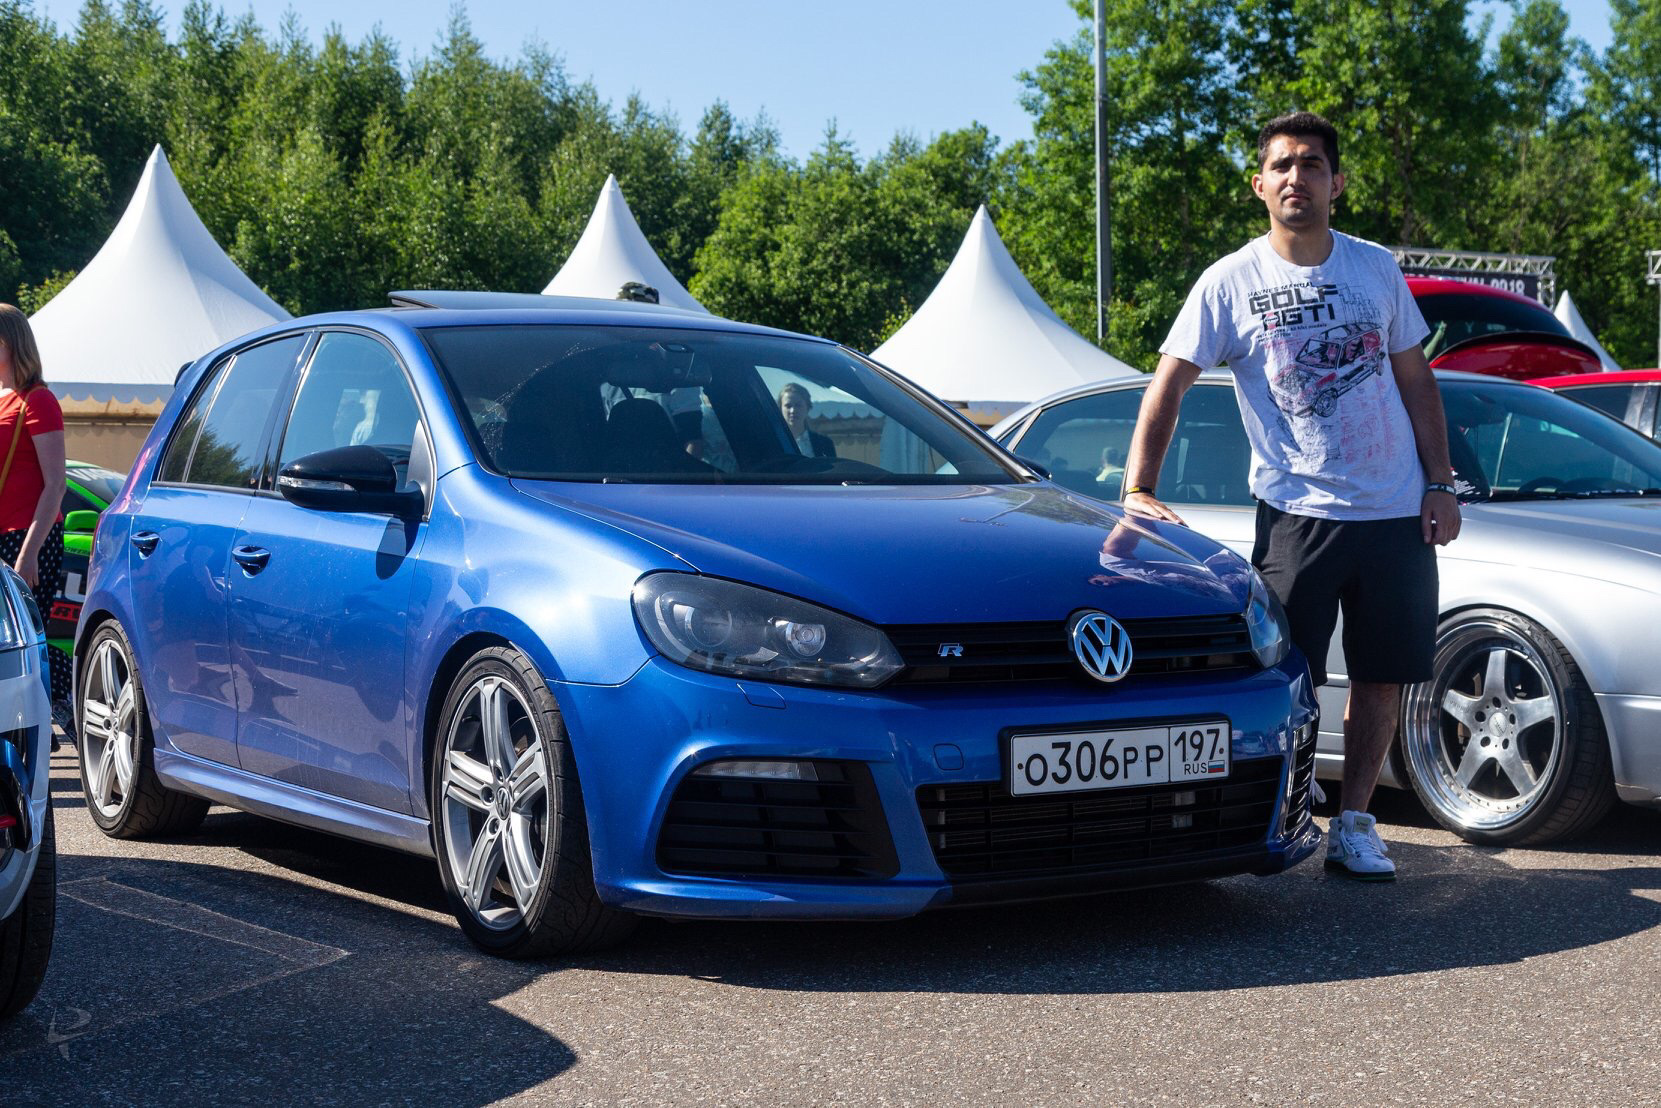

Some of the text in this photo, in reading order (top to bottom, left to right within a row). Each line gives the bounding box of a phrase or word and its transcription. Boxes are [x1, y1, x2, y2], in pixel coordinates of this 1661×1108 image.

[1249, 284, 1339, 315] GOLF
[938, 643, 964, 657] R
[1174, 728, 1220, 763] 197
[1184, 763, 1208, 776] RUS
